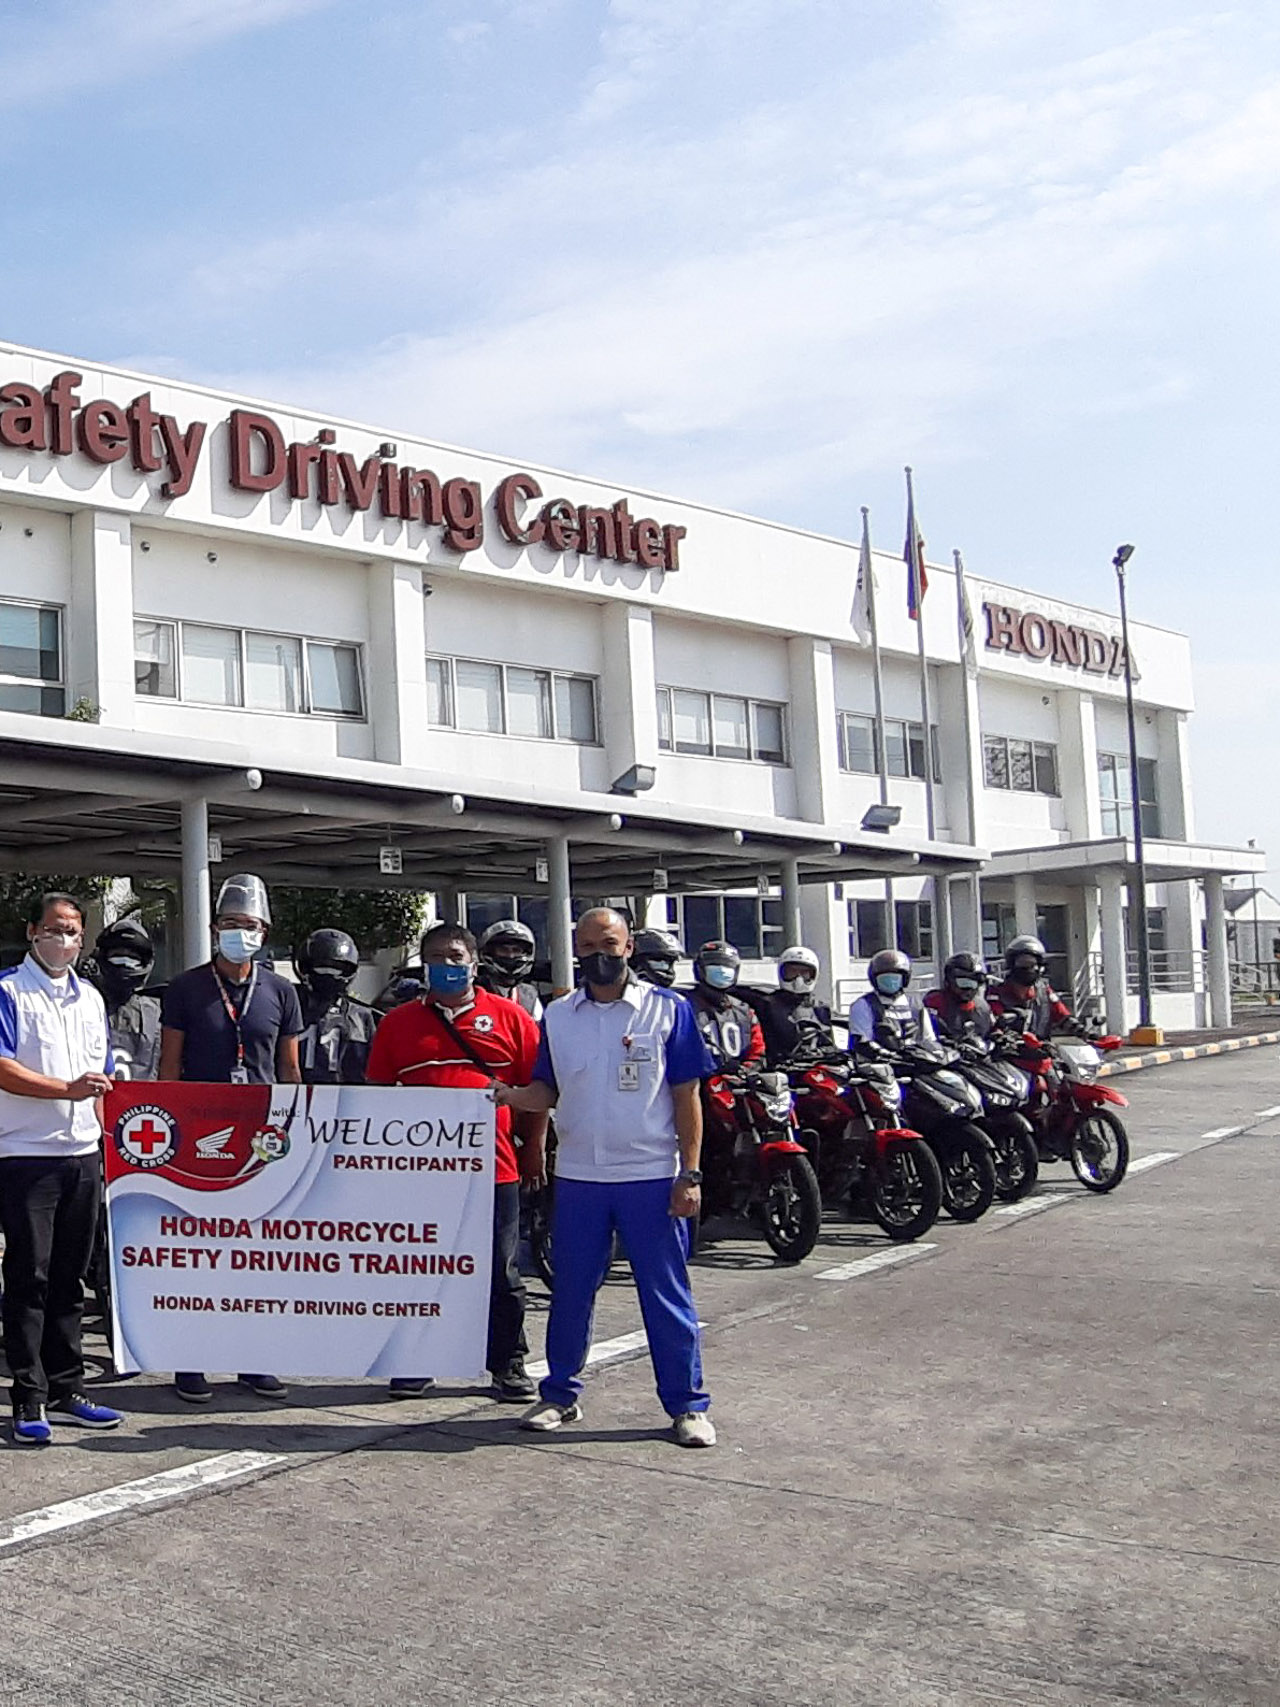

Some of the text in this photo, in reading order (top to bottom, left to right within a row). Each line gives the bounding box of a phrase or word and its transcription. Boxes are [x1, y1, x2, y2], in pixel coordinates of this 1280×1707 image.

[228, 408, 484, 553] Driving
[496, 473, 688, 572] Center
[982, 601, 1142, 682] HONDA
[703, 1020, 741, 1057] 10
[117, 1104, 177, 1127] PHILIPPINE
[307, 1116, 487, 1150] WELCOME
[117, 1146, 176, 1169] RED CROSS
[196, 1151, 236, 1160] HONDA
[333, 1154, 483, 1172] PARTICIPANTS
[160, 1216, 438, 1243] HONDA MOTORCYCLE
[121, 1247, 475, 1275] SAFETY DRIVING TRAINING
[153, 1296, 441, 1317] HONDA SAFETY DRIVING CENTER
